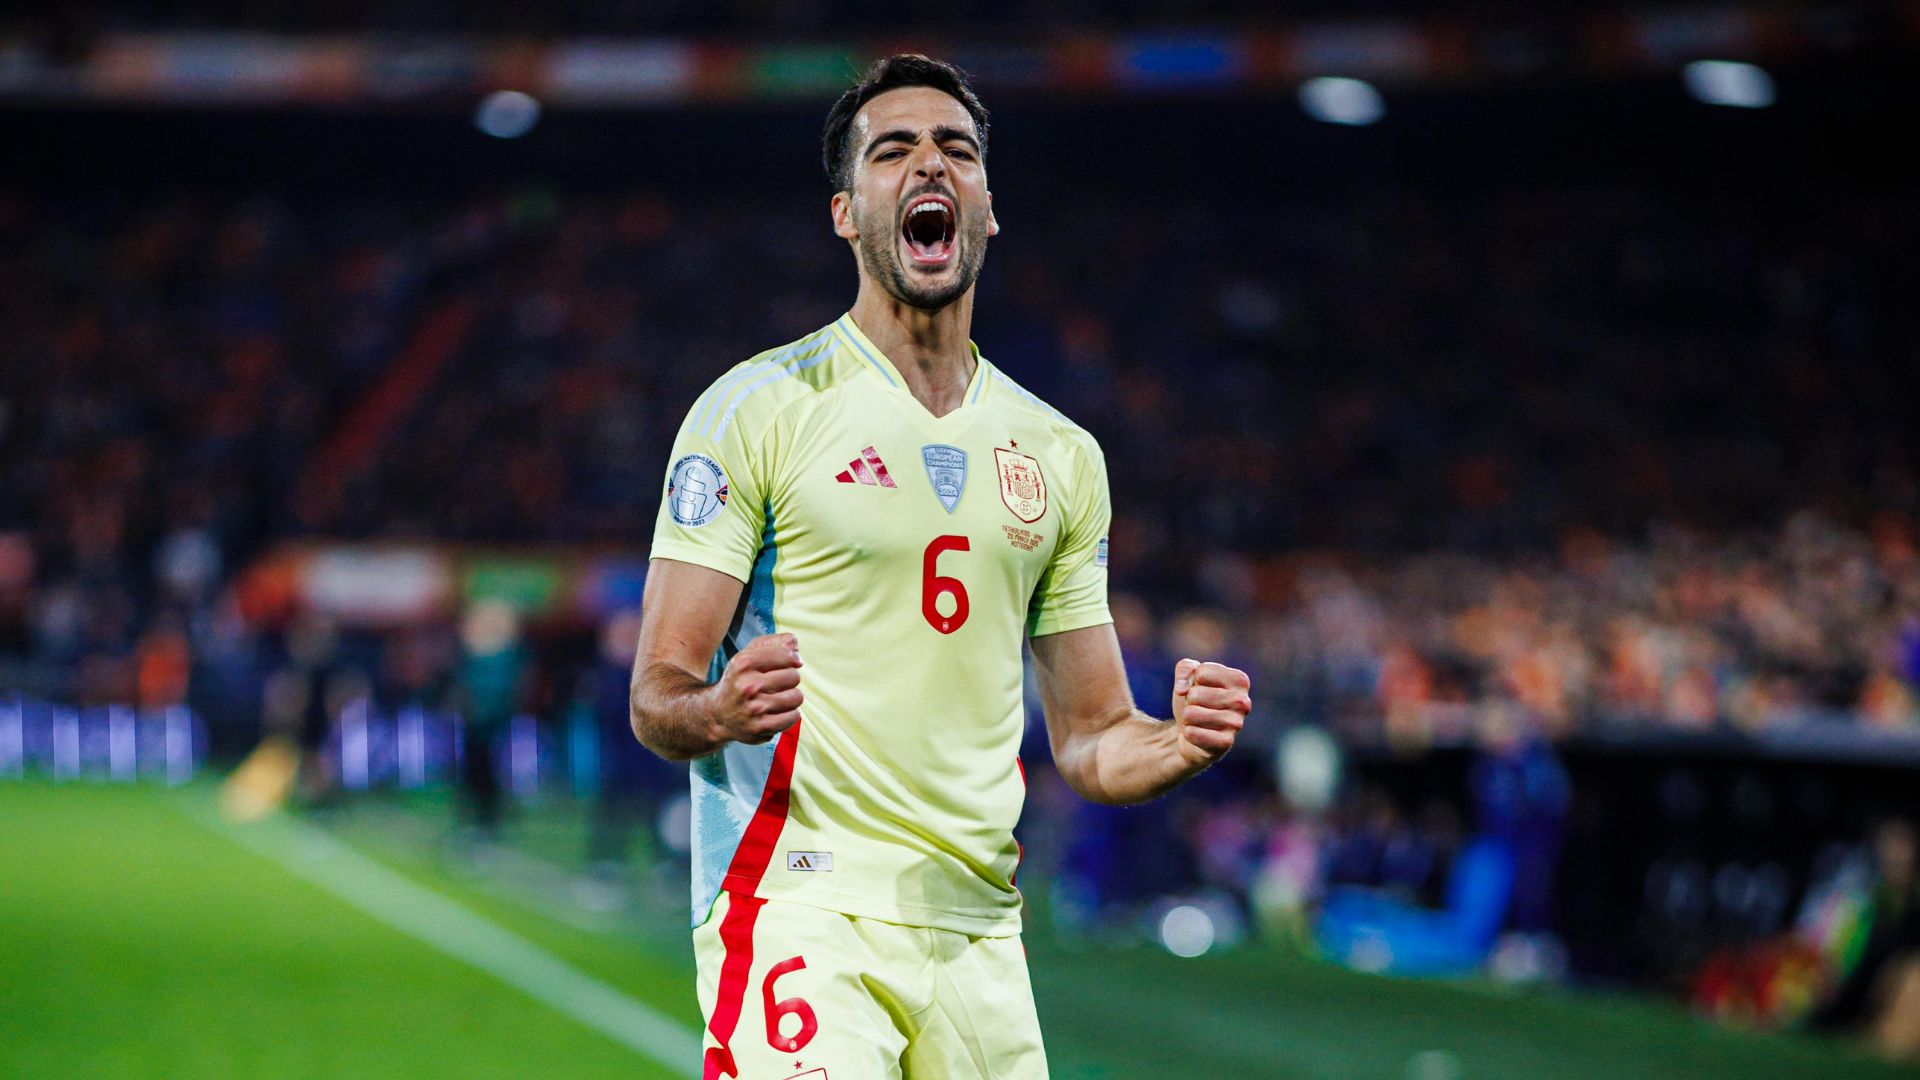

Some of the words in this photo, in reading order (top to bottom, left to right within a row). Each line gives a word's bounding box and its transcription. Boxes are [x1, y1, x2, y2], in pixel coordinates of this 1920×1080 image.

[705, 458, 723, 477] LEAGUE
[922, 535, 970, 634] 6
[762, 955, 818, 1053] 6
